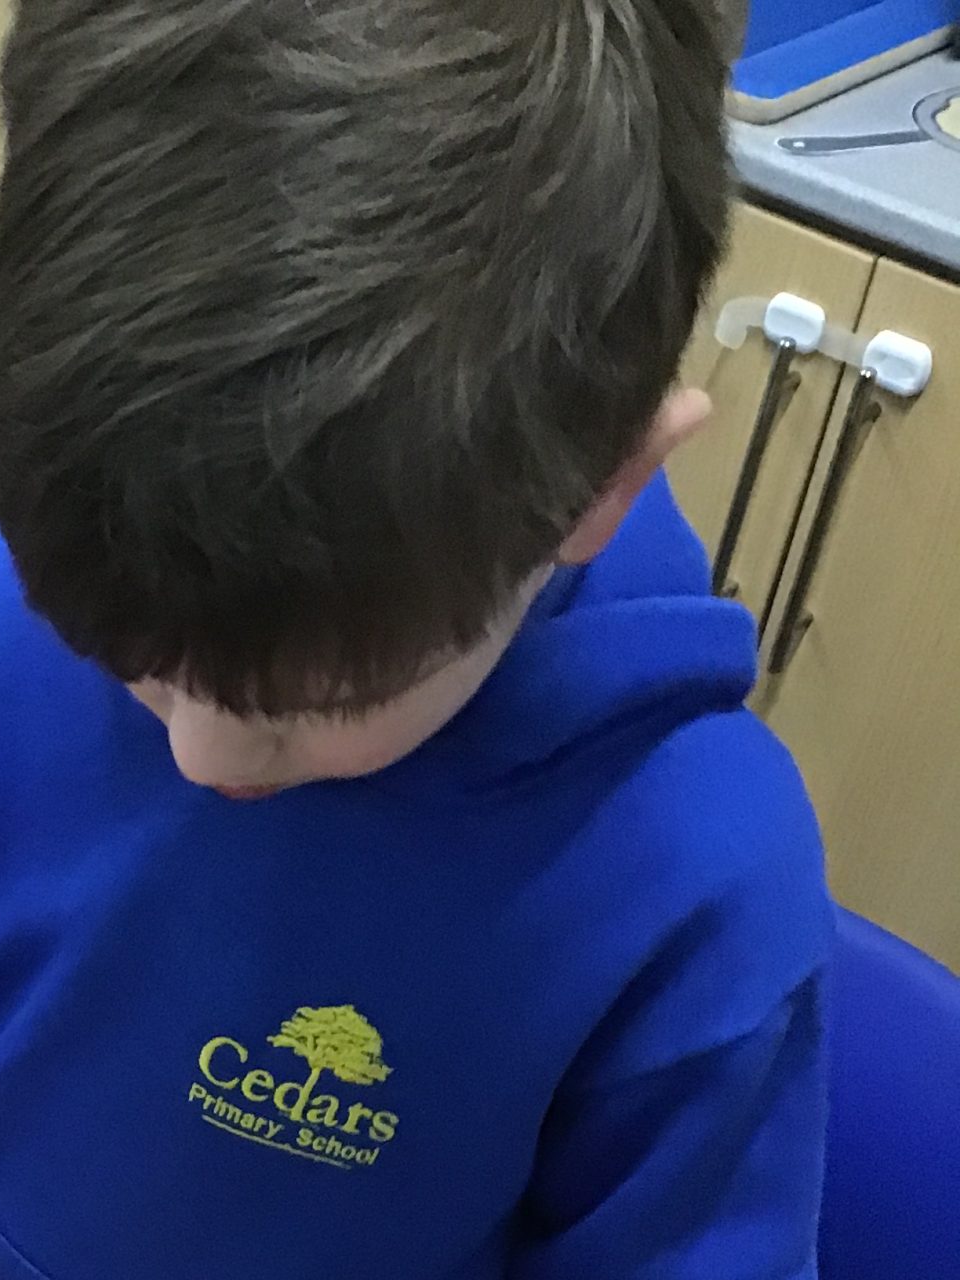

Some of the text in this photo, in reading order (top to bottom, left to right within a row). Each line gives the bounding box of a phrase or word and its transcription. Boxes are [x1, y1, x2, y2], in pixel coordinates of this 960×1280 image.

[188, 1082, 381, 1166] Primary School
[198, 1036, 400, 1142] Cedars
